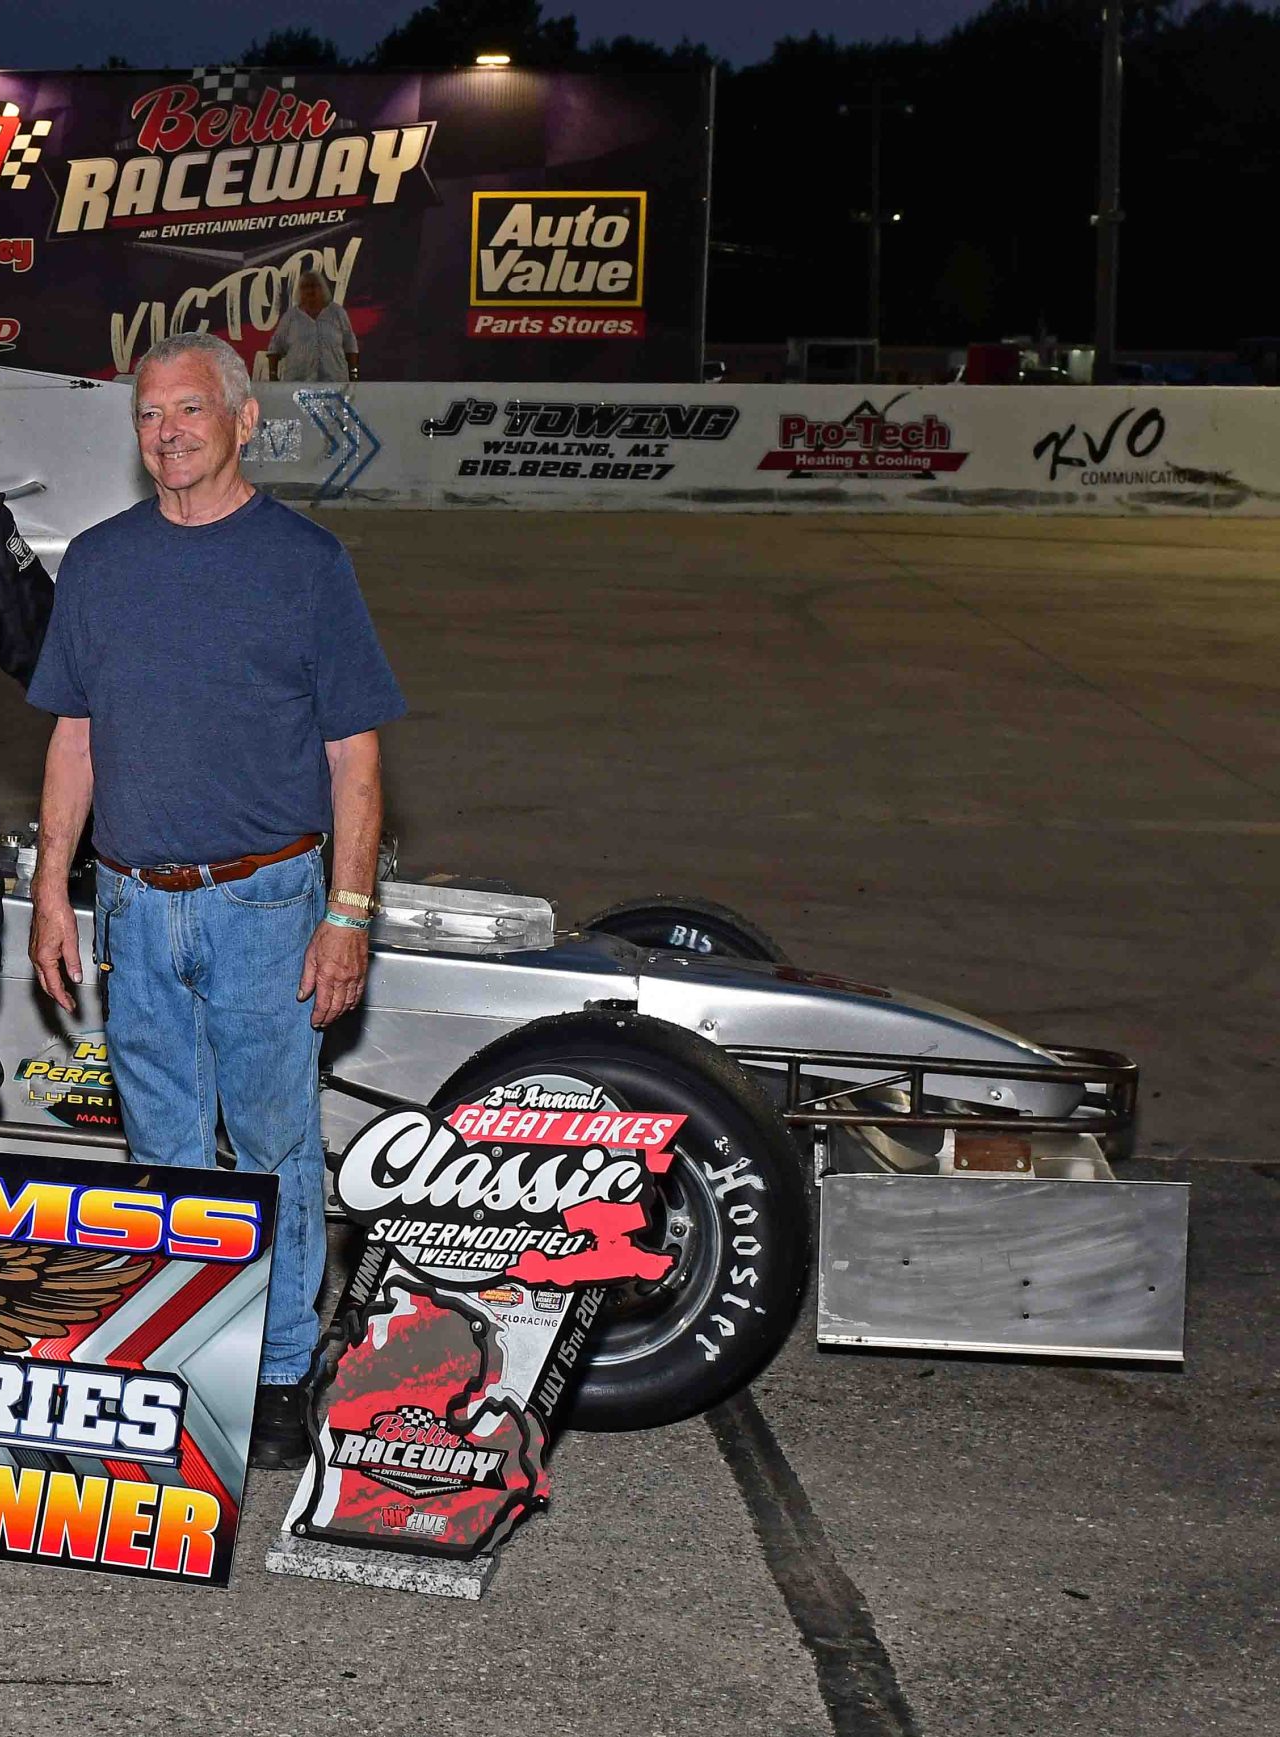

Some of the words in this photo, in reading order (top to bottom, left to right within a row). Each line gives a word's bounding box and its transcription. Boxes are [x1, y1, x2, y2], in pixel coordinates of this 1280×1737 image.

[132, 84, 335, 154] Berlin
[57, 127, 427, 233] RACEWAY
[139, 230, 158, 239] AND
[161, 216, 276, 238] ENTERTAINMENT
[279, 209, 347, 228] COMPLEX
[488, 203, 630, 248] Auto
[480, 249, 633, 293] Value
[474, 315, 543, 334] Parts
[504, 401, 740, 439] TOWING
[779, 413, 951, 449] Pro-Tech
[626, 444, 669, 458] MI
[795, 454, 853, 469] Heating
[859, 455, 869, 465] &
[875, 454, 931, 469] Cooling
[1081, 470, 1208, 485] COMMUNICATIO
[485, 1086, 521, 1107] 2nd
[520, 1085, 603, 1110] Annual
[454, 1108, 562, 1140] GREAT
[563, 1114, 673, 1145] LAKES
[337, 1118, 643, 1213] Classic
[368, 1218, 586, 1256] SUPERMODIFIED
[419, 1249, 510, 1270] WEEKEND
[538, 1363, 566, 1417] JULY
[557, 1327, 586, 1369] 15TH
[575, 1287, 607, 1330] 202
[373, 1414, 463, 1449] Berlin
[337, 1433, 501, 1482] RACEWAY
[381, 1469, 432, 1481] ENTERTAINMENT
[432, 1475, 463, 1485] COMPLEX
[407, 1512, 449, 1534] FIVE
